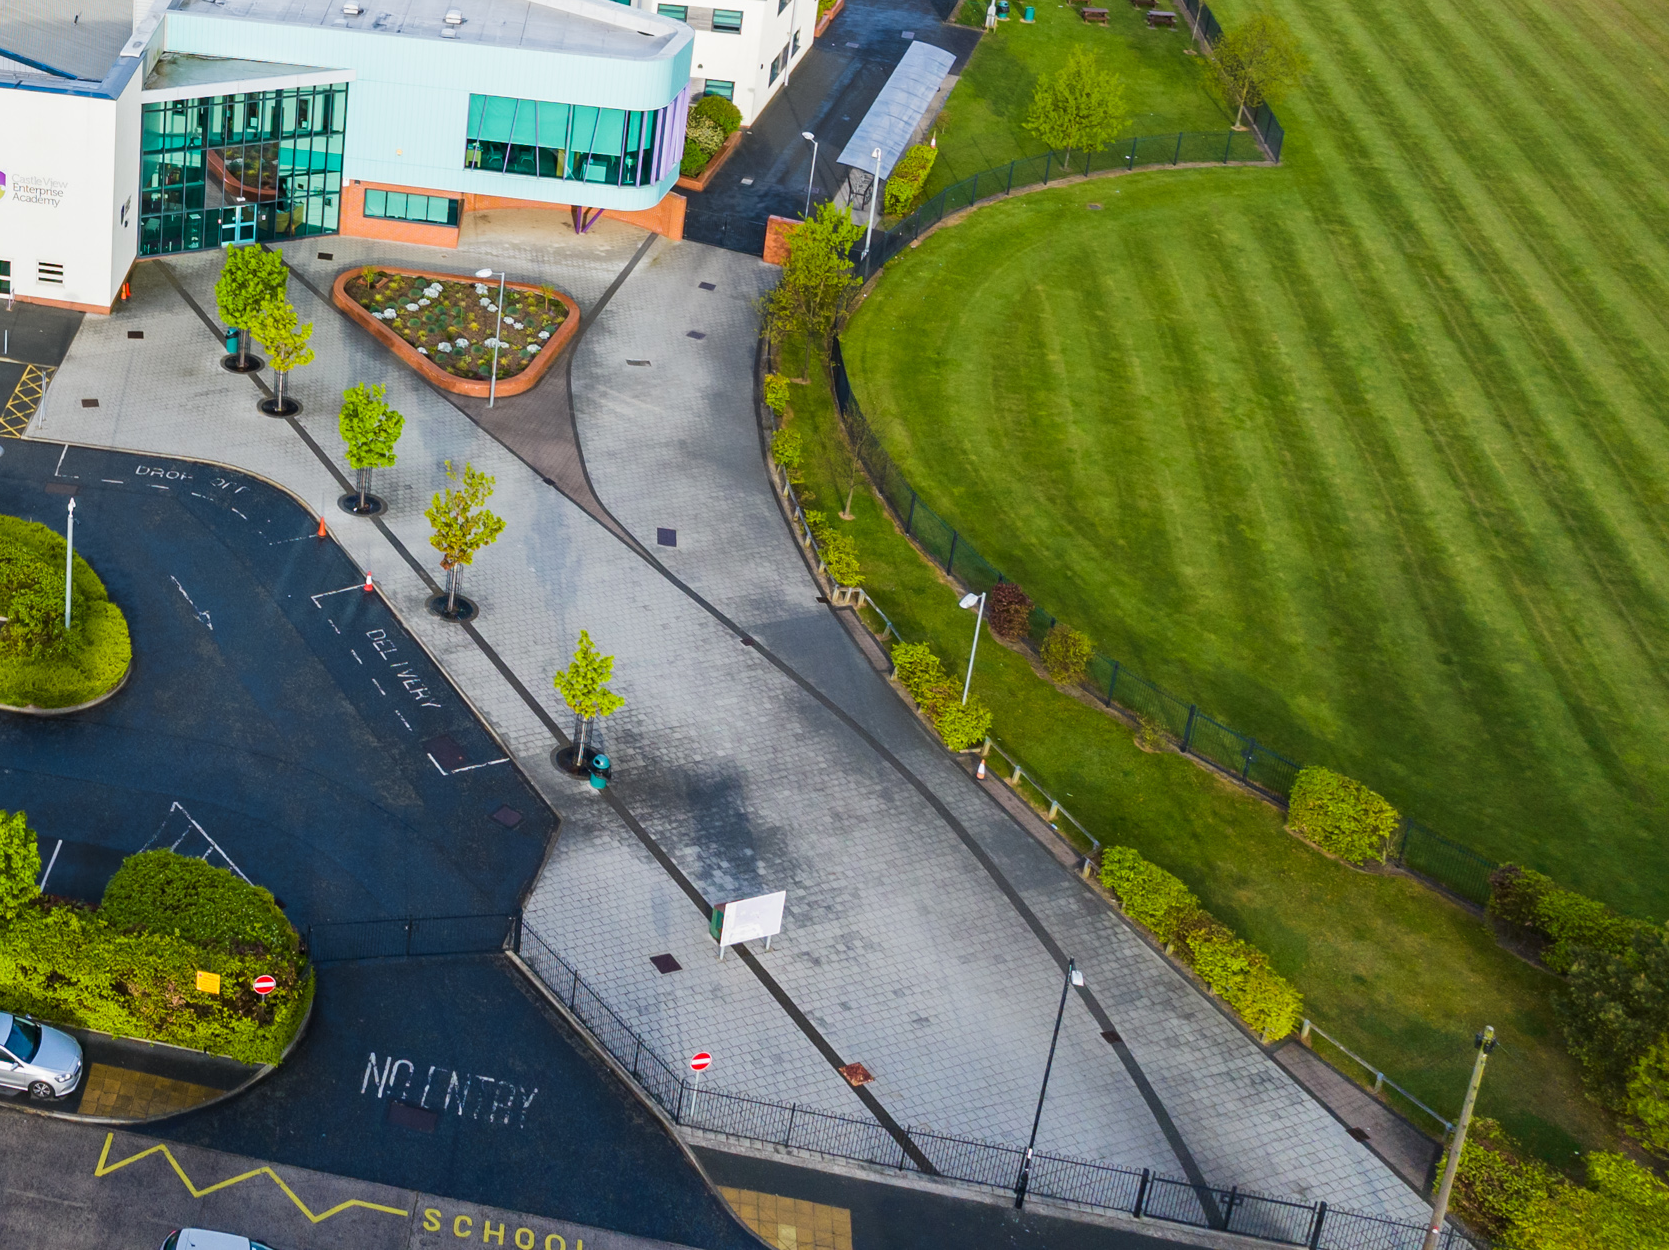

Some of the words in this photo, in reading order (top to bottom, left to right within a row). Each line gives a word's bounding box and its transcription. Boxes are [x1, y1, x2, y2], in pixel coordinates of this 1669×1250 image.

[12, 174, 42, 185] Castle
[42, 177, 68, 189] View
[12, 192, 60, 208] Academy
[13, 182, 64, 202] Enterprise
[366, 629, 441, 707] DELIVERY
[361, 1052, 414, 1101] NO
